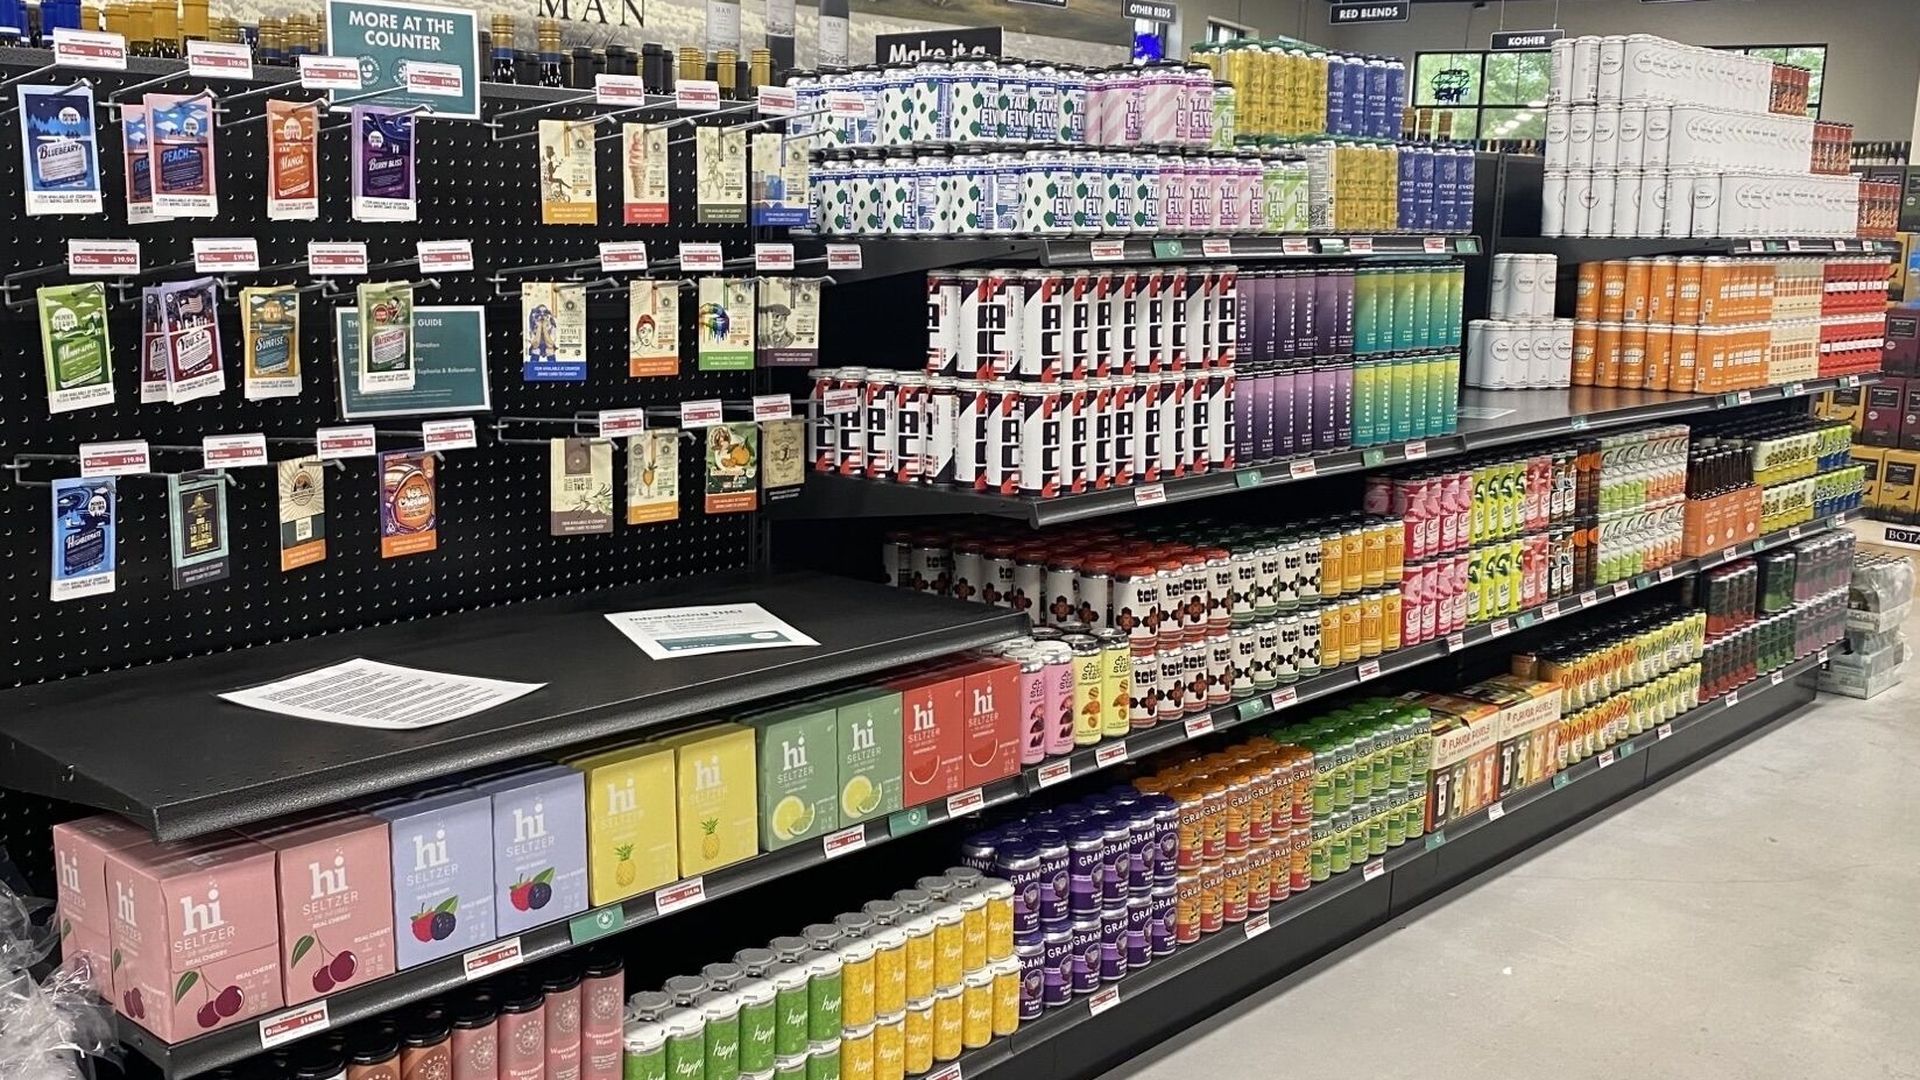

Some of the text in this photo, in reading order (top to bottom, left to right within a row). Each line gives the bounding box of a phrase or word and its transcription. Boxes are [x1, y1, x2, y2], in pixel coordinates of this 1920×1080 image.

[350, 10, 454, 34] MORE AT THE
[1130, 4, 1171, 18] OTHER REDS
[1339, 7, 1398, 19] RED BLENDS
[364, 30, 442, 51] COUNTER
[888, 40, 946, 62] Make
[952, 39, 966, 59] it
[1508, 36, 1546, 46] KOSHER
[973, 685, 994, 715] hi
[912, 700, 936, 732] hi
[968, 712, 1000, 728] SELTZER
[852, 719, 875, 750] hi
[908, 728, 941, 742] SELTZER
[782, 736, 807, 770] hi
[846, 746, 882, 764] SELTZER
[695, 754, 722, 790] hi
[776, 764, 814, 784] SELTZER
[608, 778, 636, 816] hi
[513, 803, 545, 843] hi
[413, 830, 450, 870] hi
[506, 834, 555, 858] SELTZER
[60, 850, 81, 894] hi
[309, 856, 348, 900] hi
[406, 864, 459, 886] SELTZER
[116, 880, 136, 927] hi
[180, 888, 225, 936] hi
[302, 891, 359, 916] SELTZER
[174, 926, 236, 953] SELTZER
[236, 963, 278, 981] REAL CHERRY
